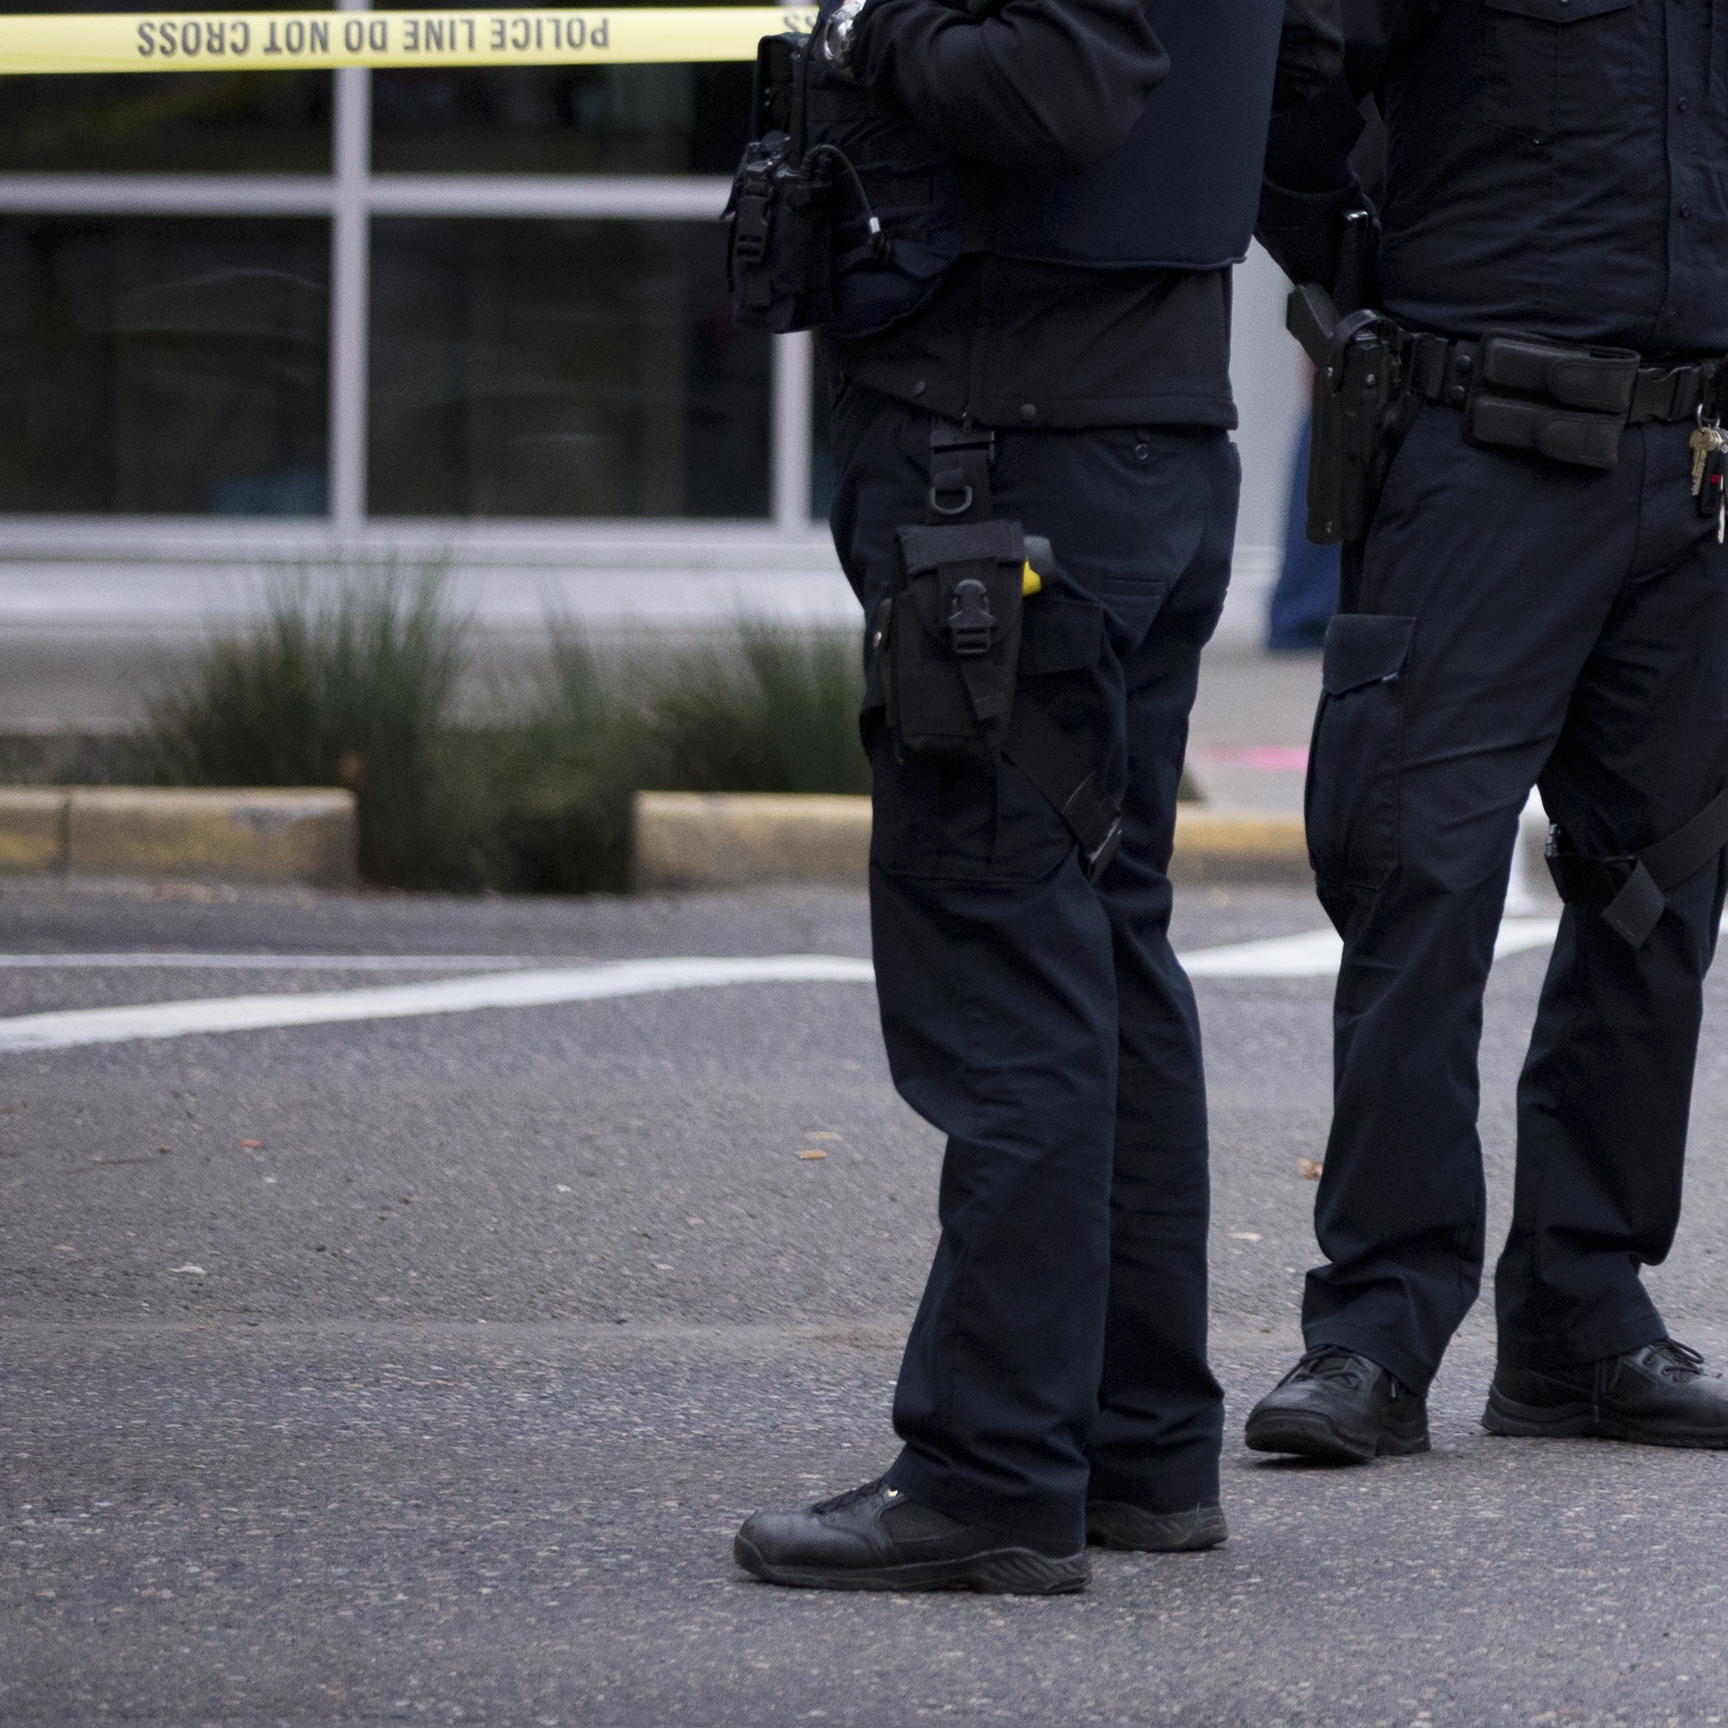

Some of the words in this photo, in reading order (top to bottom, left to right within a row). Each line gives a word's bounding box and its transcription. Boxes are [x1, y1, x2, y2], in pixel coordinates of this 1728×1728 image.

[136, 20, 251, 57] CROSS
[263, 20, 330, 55] NOT
[344, 19, 388, 53] DO
[403, 18, 477, 52] LINE
[490, 16, 610, 50] POLICE
